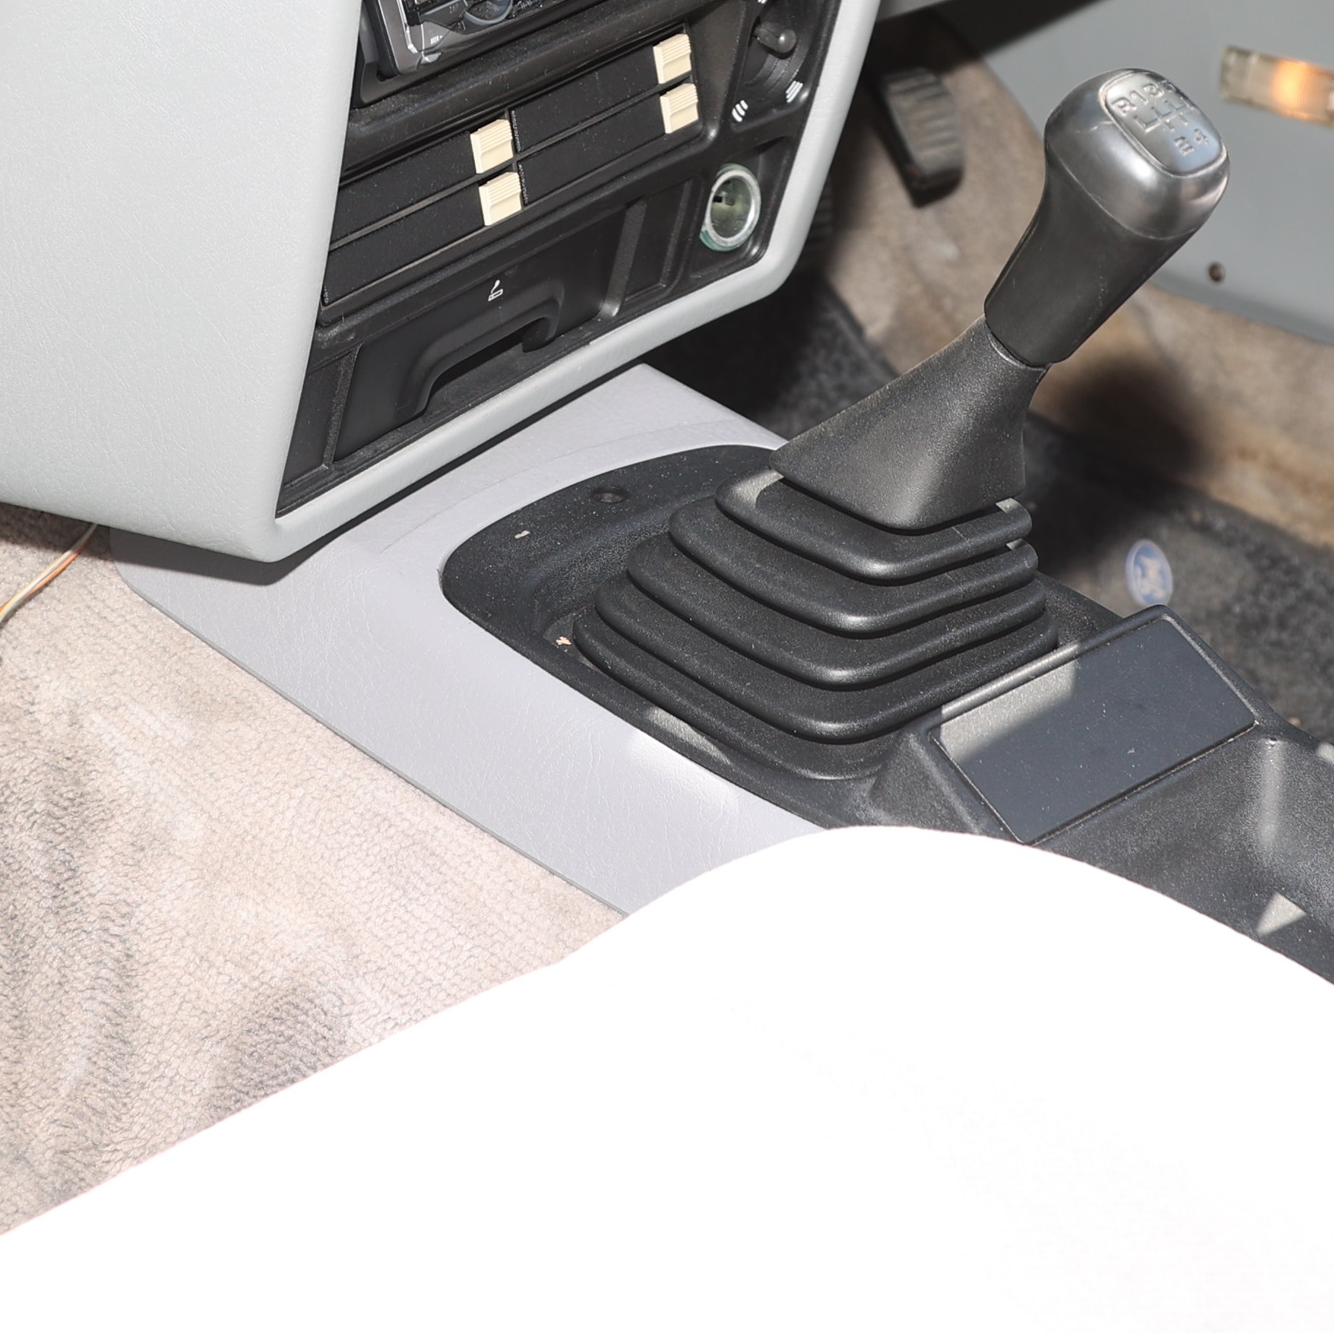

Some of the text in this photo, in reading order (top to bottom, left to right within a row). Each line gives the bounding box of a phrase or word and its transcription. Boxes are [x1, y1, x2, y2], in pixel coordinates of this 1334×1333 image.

[1111, 97, 1137, 116] R
[1130, 90, 1149, 106] 1
[1142, 83, 1165, 99] 3
[1194, 128, 1208, 144] 4
